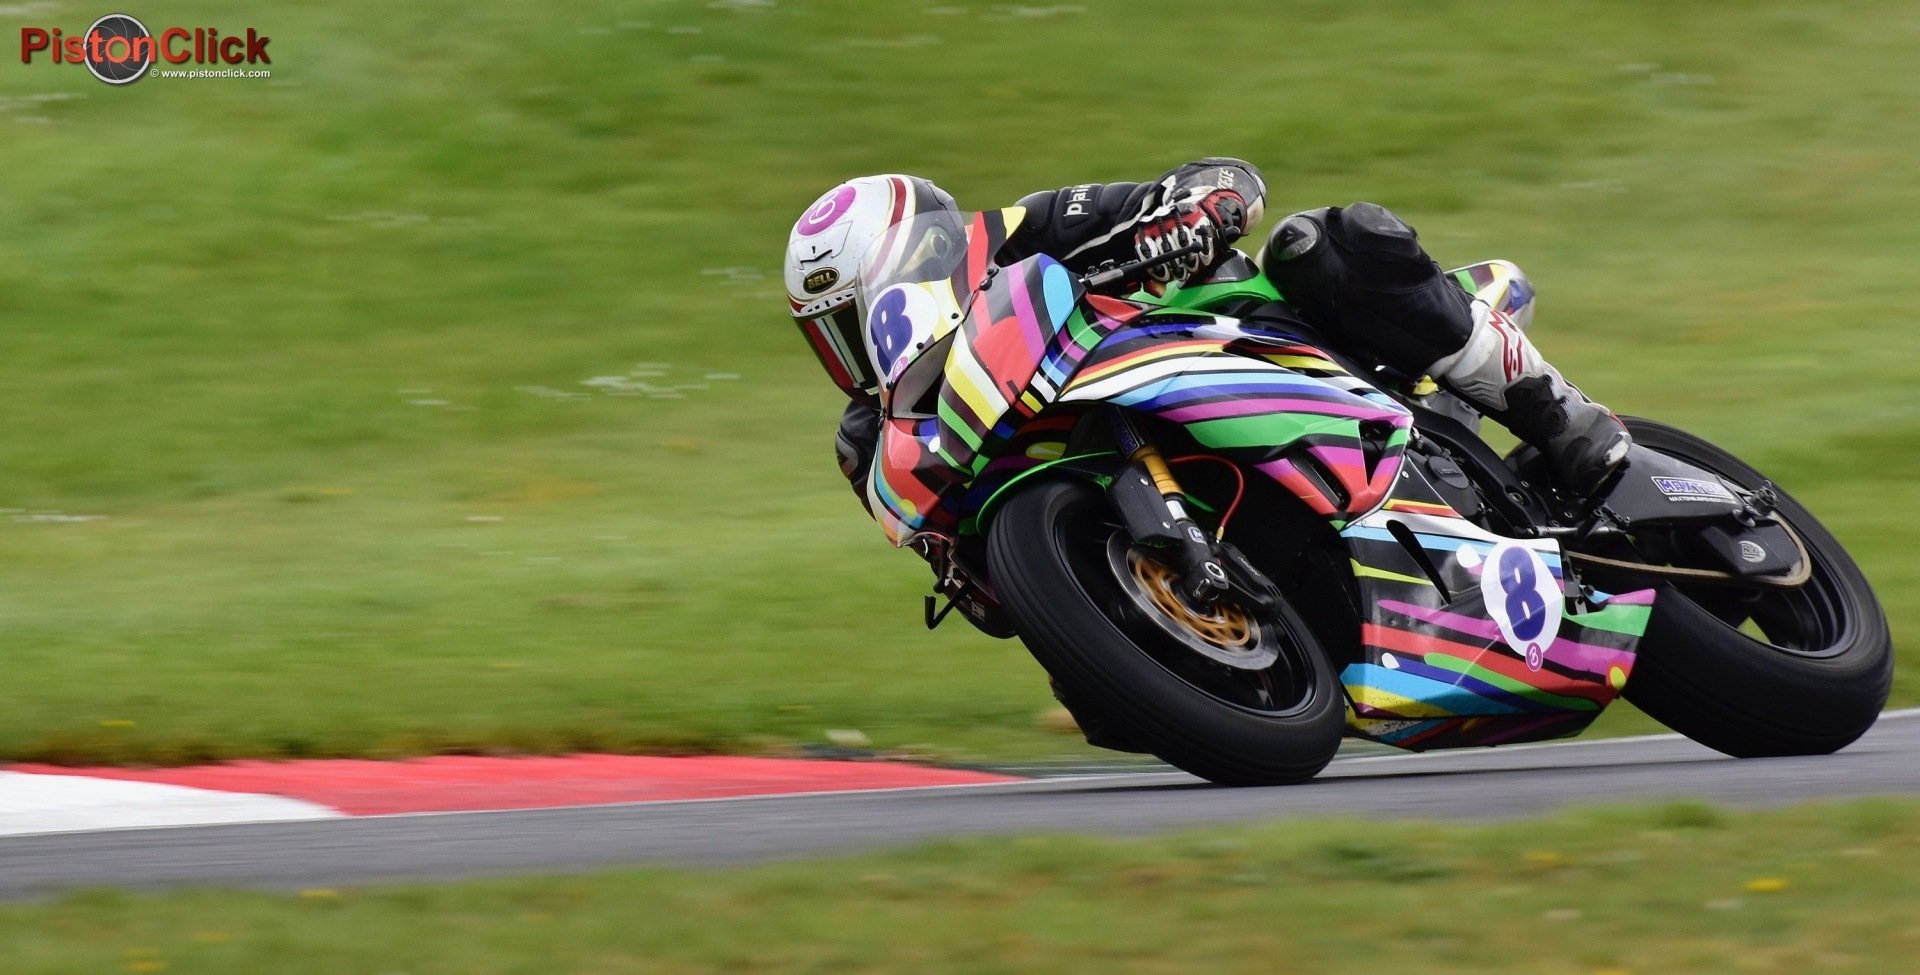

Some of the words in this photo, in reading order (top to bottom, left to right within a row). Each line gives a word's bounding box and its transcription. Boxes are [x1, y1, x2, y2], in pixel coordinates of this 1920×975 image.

[807, 271, 835, 289] BELL
[870, 287, 913, 378] 8
[1499, 546, 1546, 642] 8
